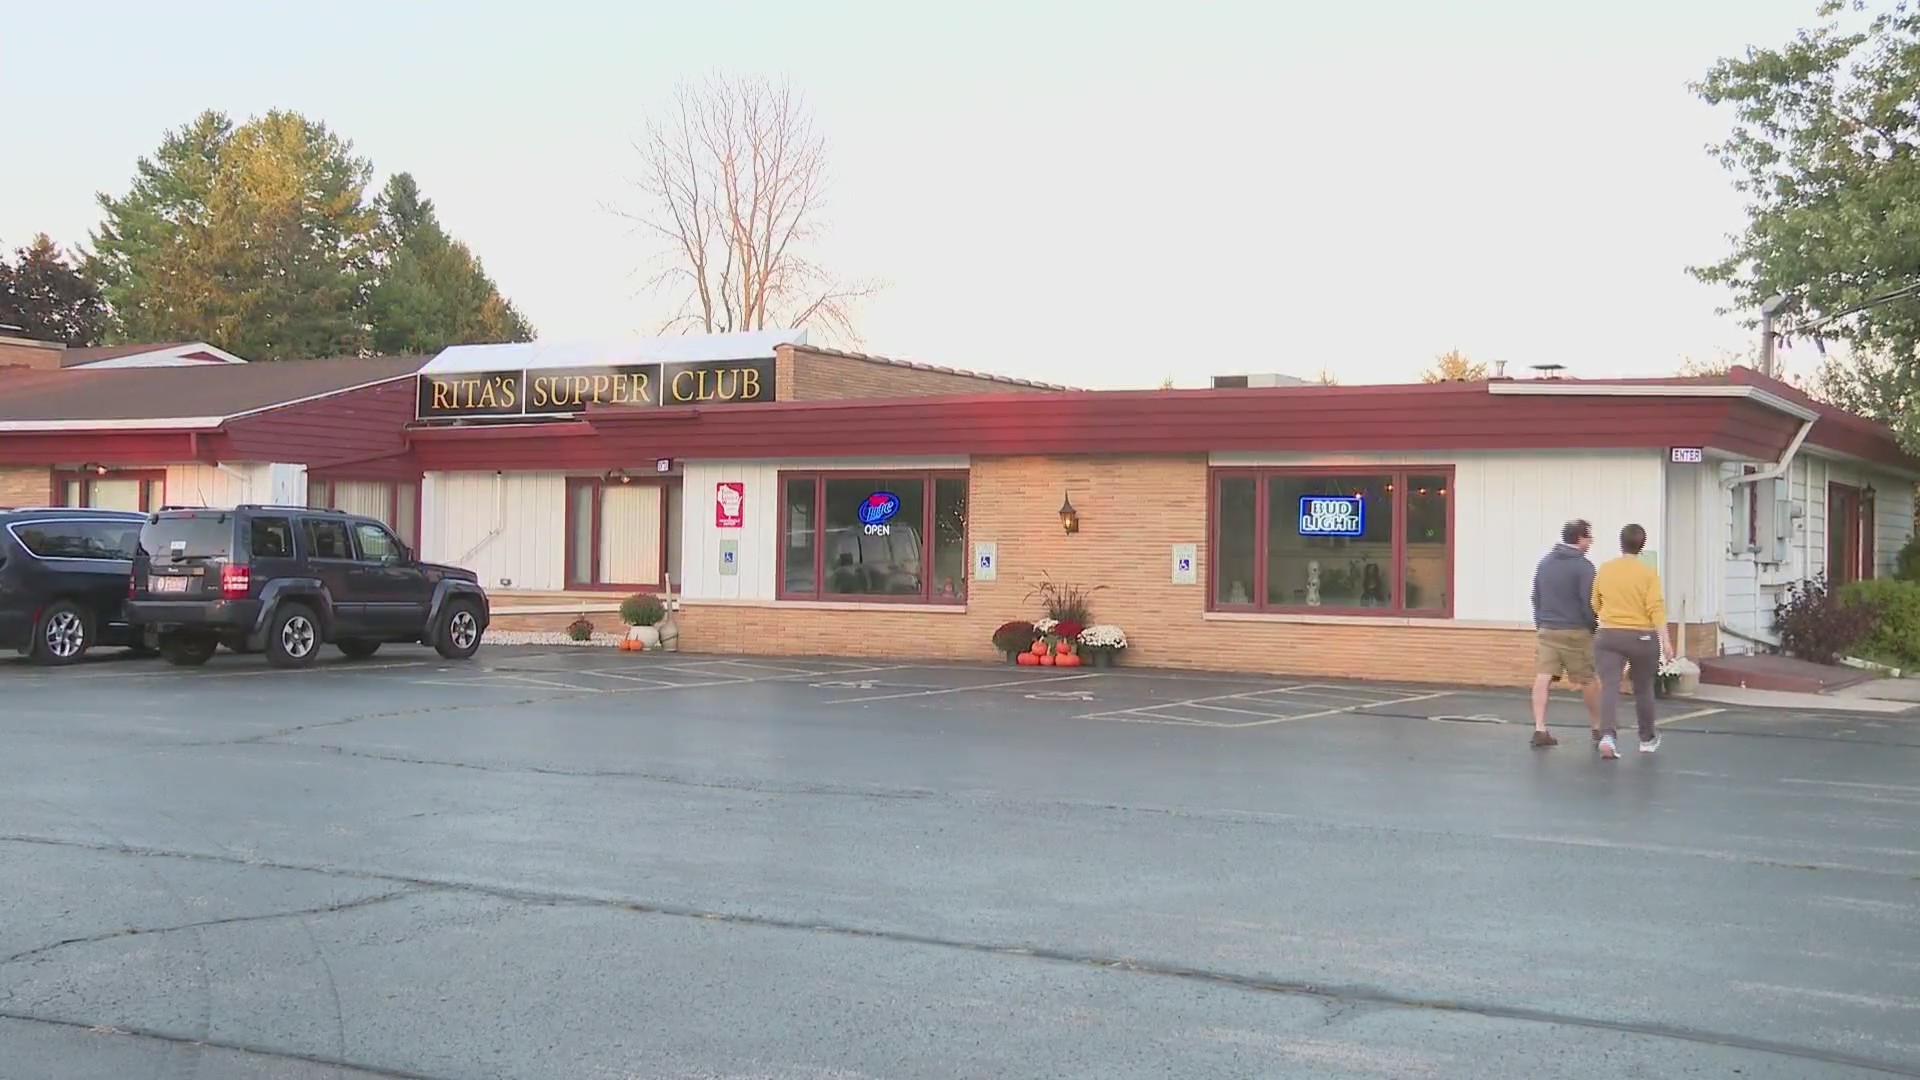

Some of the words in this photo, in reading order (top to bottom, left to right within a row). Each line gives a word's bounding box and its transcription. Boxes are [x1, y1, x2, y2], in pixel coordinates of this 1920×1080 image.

[431, 377, 516, 409] RITA'S
[533, 373, 651, 407] SUPPER
[671, 368, 761, 401] CLUB
[1674, 449, 1700, 460] ENTER
[1311, 500, 1351, 516] BUD
[864, 524, 890, 536] OPEN
[1302, 515, 1359, 531] LIGHT
